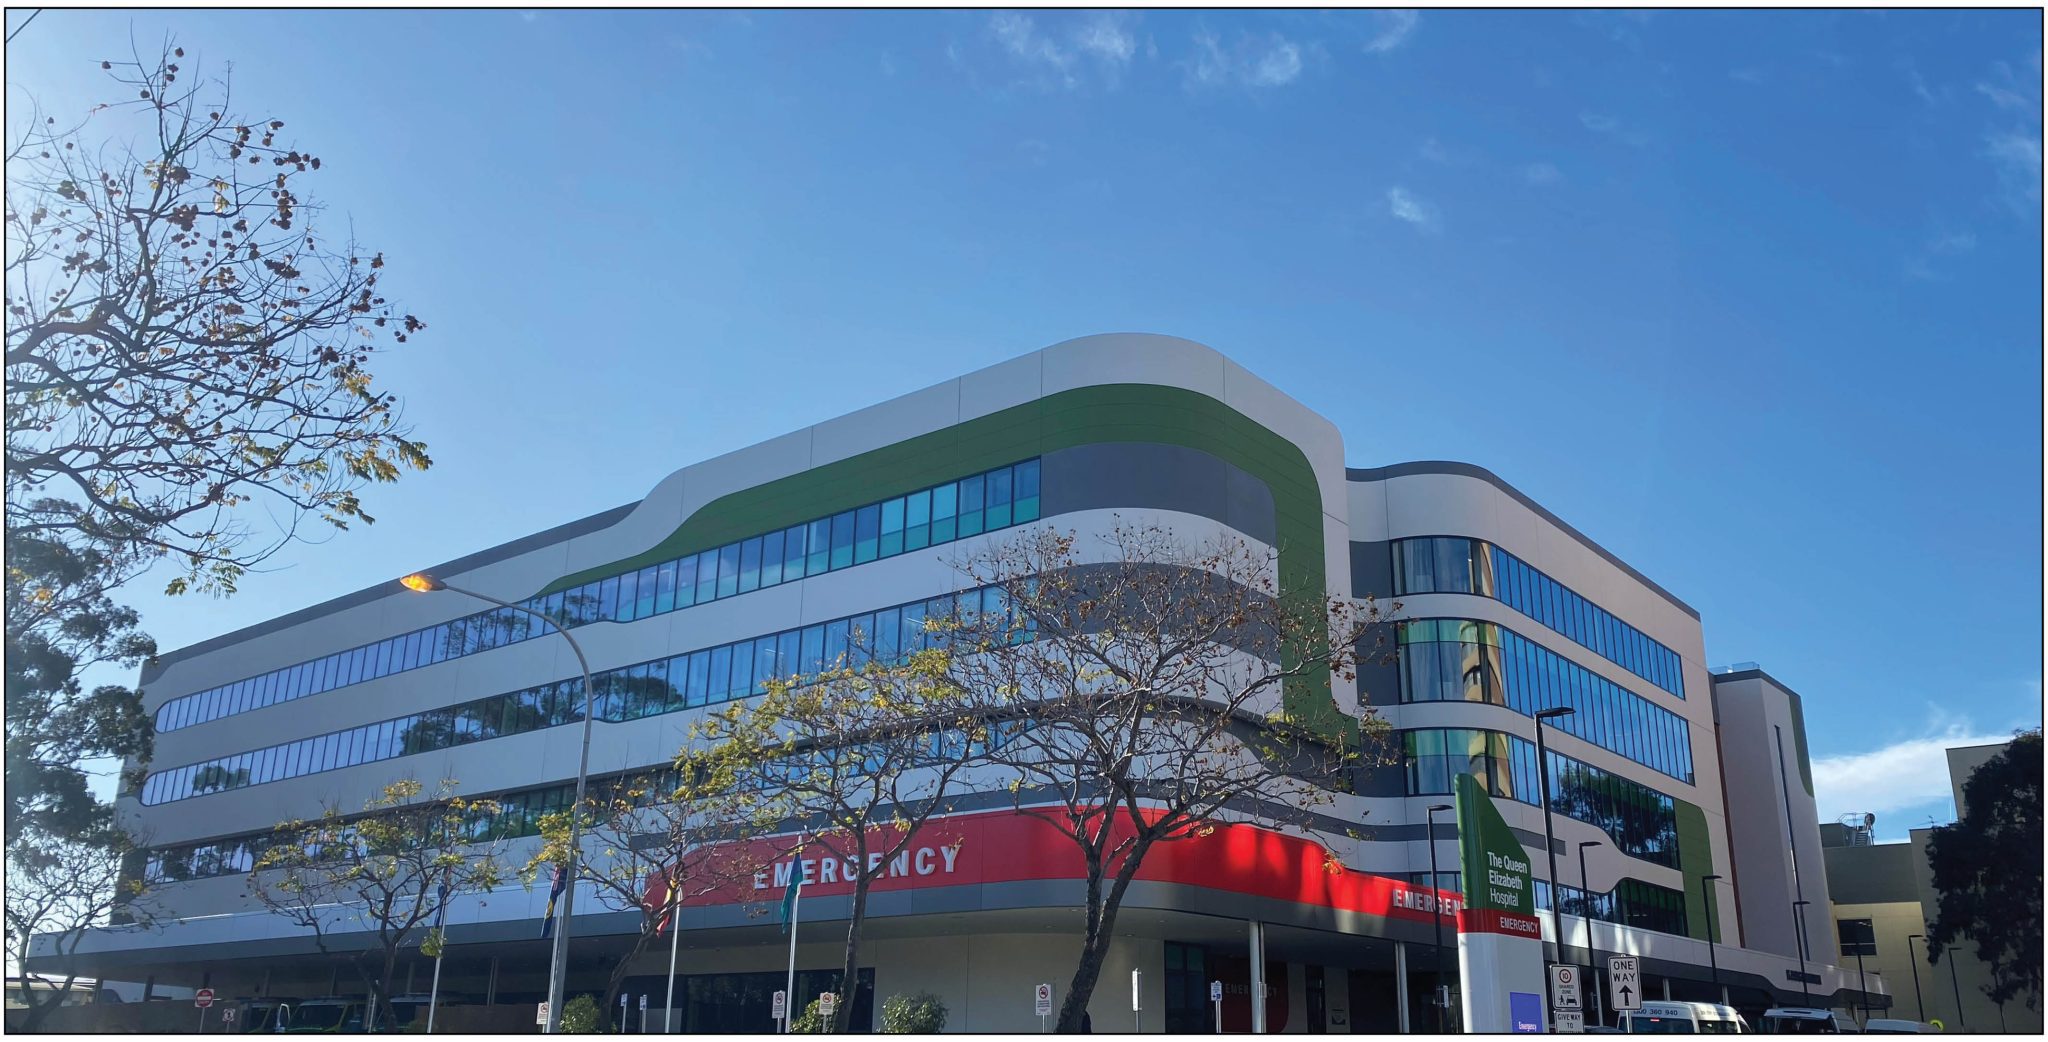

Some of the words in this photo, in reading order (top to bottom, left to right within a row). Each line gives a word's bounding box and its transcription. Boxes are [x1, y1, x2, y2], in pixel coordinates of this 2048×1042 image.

[754, 846, 962, 889] EMERGENCY
[1487, 851, 1502, 868] The
[1503, 855, 1528, 874] Queen
[1488, 869, 1523, 890] Elizabeth
[1392, 889, 1461, 917] EMERGEN
[1490, 887, 1519, 908] Hospital
[1499, 916, 1539, 933] EMERGENCY
[1613, 960, 1634, 970] ONE
[1562, 972, 1569, 980] 10
[1612, 972, 1635, 982] WAY
[1225, 983, 1278, 998] EMERCY
[1571, 1013, 1581, 1021] WAY
